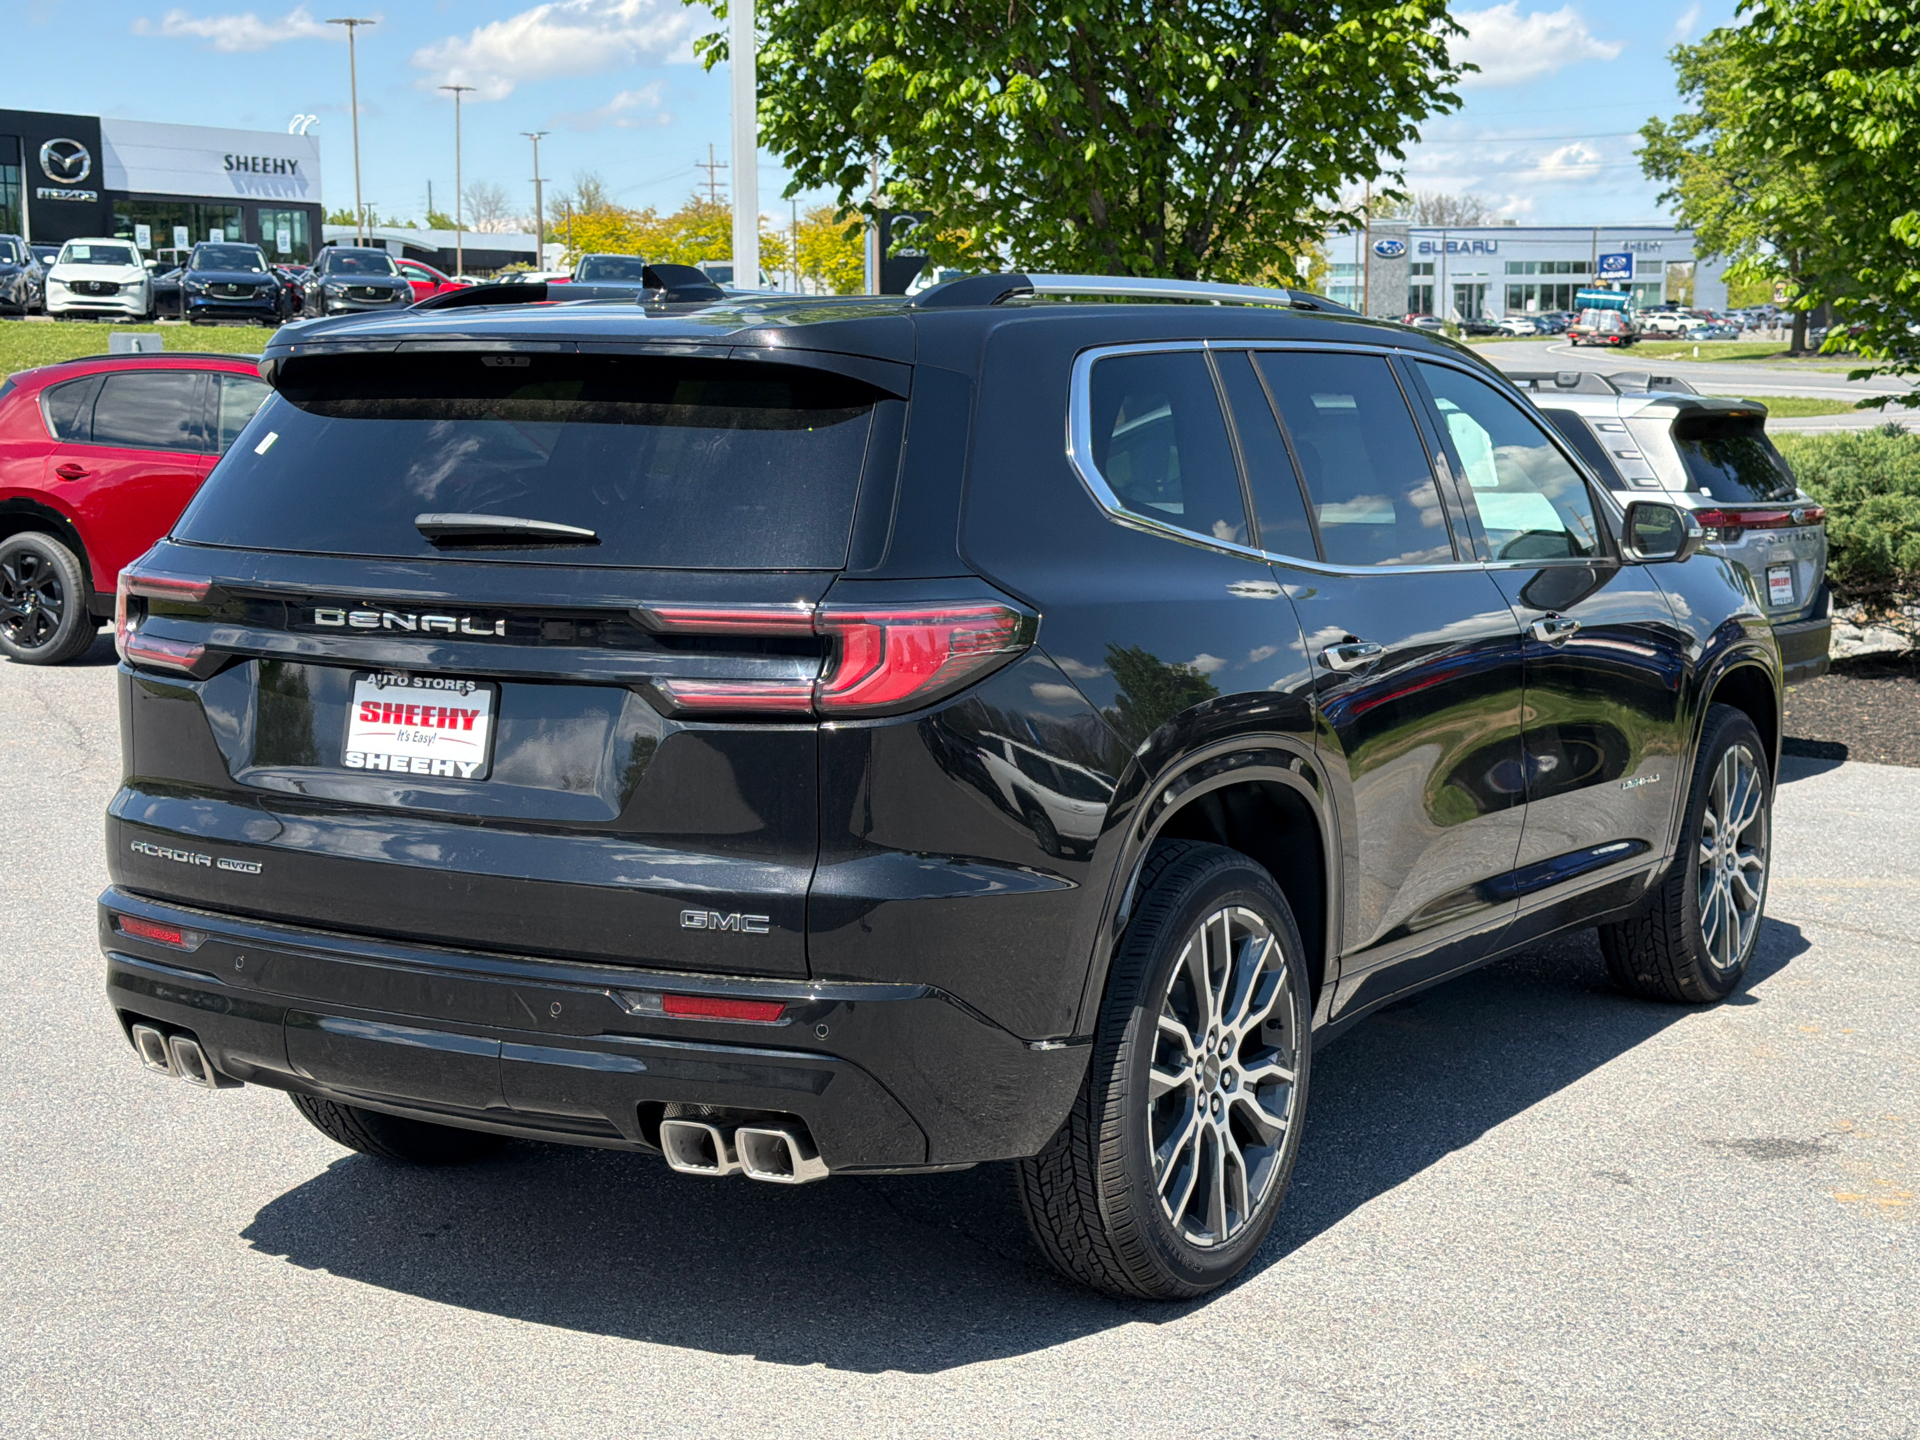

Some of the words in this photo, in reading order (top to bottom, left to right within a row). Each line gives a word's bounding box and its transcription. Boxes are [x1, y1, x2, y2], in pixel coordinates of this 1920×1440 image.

[223, 154, 299, 175] SHEEHY
[1418, 240, 1499, 255] SUBARU
[314, 608, 506, 637] DENALI
[367, 673, 409, 687] AUTO
[413, 677, 476, 692] STORES
[359, 700, 481, 731] SHEEHY
[396, 729, 411, 742] It's
[412, 730, 437, 747] Easy!
[345, 752, 480, 779] SHEEHY
[130, 840, 212, 867] ACADIA
[218, 858, 261, 873] AWD
[680, 909, 770, 934] GMC
